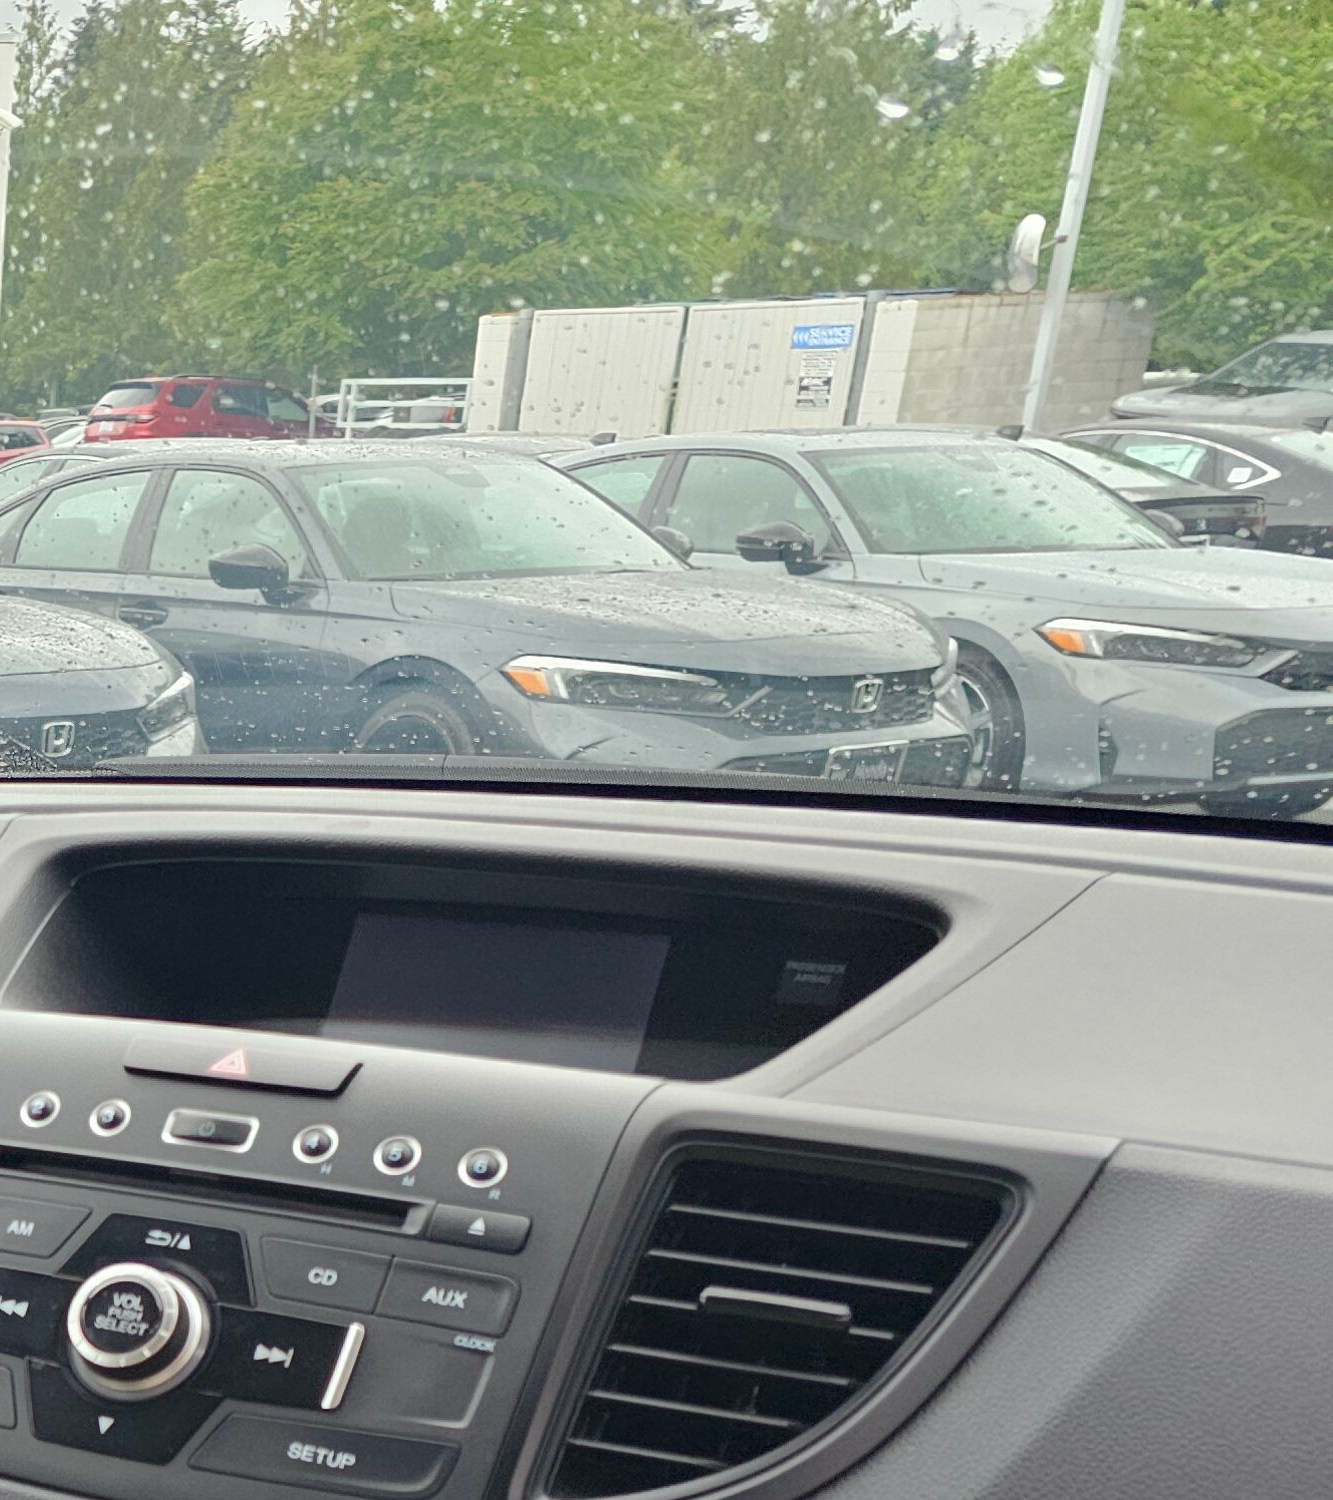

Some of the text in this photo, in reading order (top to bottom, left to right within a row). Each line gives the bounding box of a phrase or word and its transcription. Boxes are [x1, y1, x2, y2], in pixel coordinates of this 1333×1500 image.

[387, 1147, 402, 1162] 5
[473, 1159, 488, 1174] 6
[6, 1220, 34, 1237] AM
[307, 1266, 338, 1287] CD
[113, 1292, 144, 1313] VOL
[421, 1286, 468, 1309] AUX
[108, 1306, 144, 1322] PUSH
[94, 1315, 148, 1337] SELECT
[453, 1334, 497, 1353] CLOCK
[286, 1440, 357, 1470] SETUP
